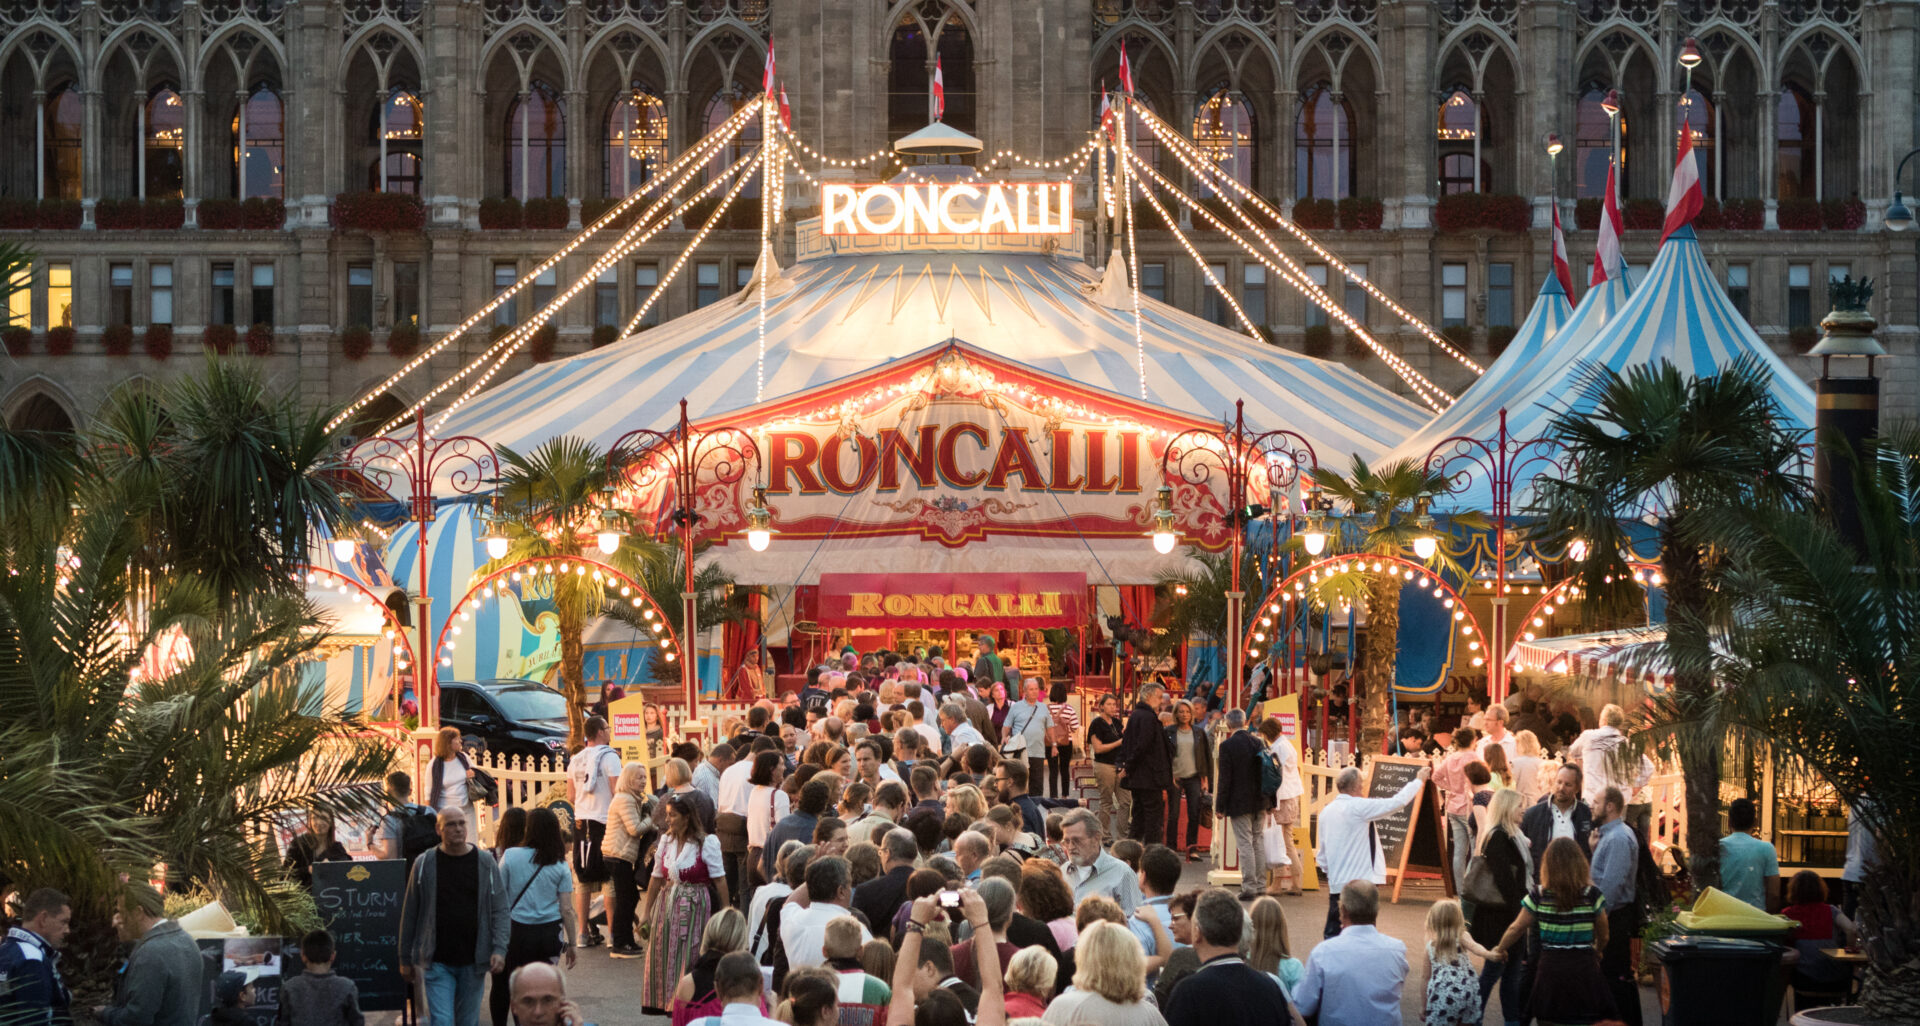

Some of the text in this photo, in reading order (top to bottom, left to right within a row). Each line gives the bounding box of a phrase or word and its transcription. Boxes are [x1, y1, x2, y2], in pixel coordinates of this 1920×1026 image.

[823, 183, 1070, 234] RONCALLI
[766, 421, 1143, 496] RONCALLI
[846, 592, 1063, 618] RONCALLI
[614, 716, 639, 725] Kronen
[615, 725, 639, 734] Zeitung
[319, 886, 398, 908] STURM
